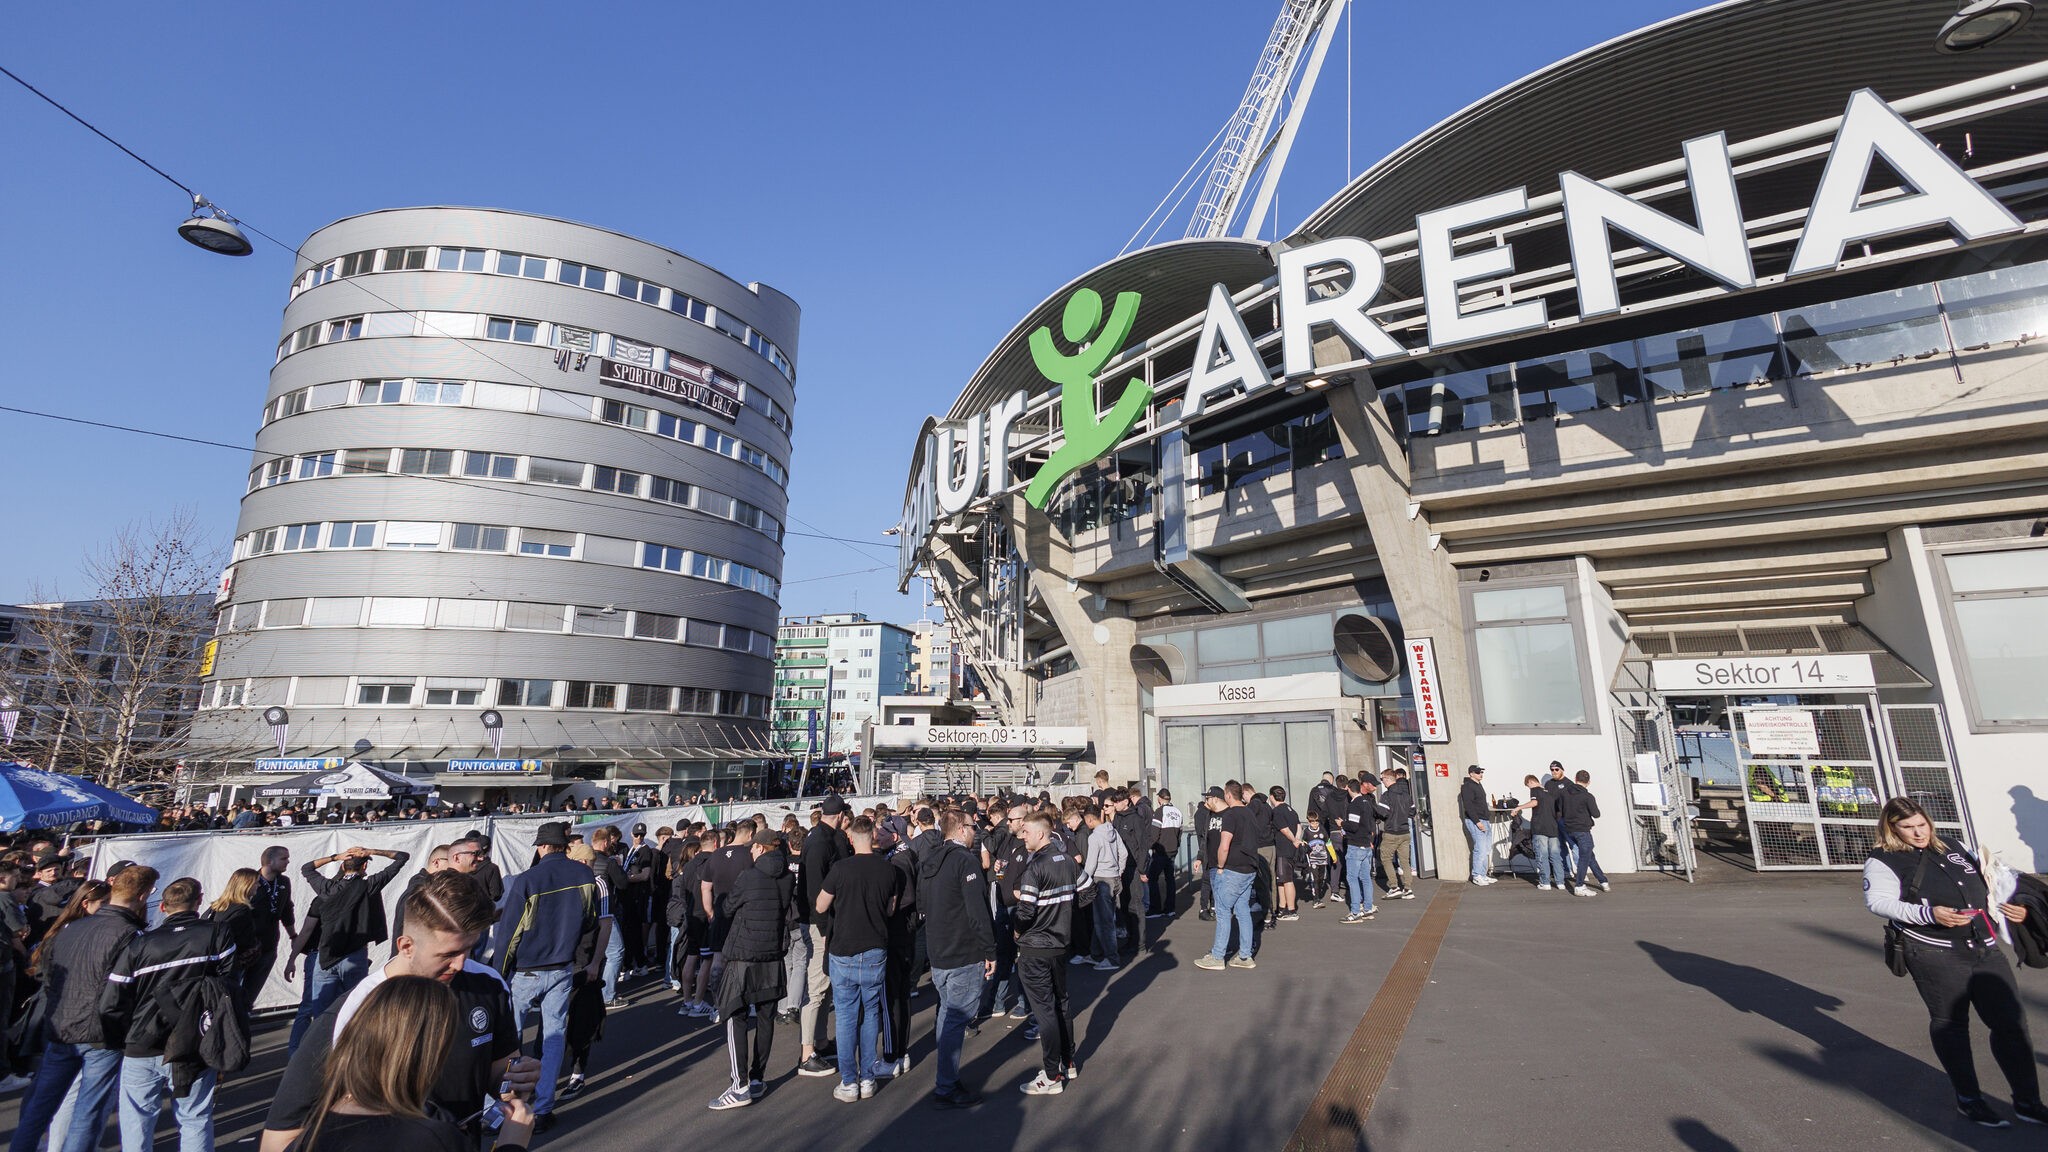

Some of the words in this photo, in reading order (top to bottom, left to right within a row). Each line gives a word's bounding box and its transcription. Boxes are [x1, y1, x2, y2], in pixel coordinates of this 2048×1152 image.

[1181, 88, 2026, 418] ARENA
[613, 363, 677, 393] SPORTKLUB
[680, 380, 710, 404] STURM
[712, 393, 733, 415] GRAZ
[1695, 662, 1780, 684] Sektor
[1791, 660, 1824, 683] 14
[1219, 684, 1255, 701] Kassa
[1412, 645, 1438, 735] WETTANNAHME
[928, 728, 987, 743] Sektoren
[991, 728, 1008, 743] 09
[1022, 729, 1037, 743] 13
[257, 760, 319, 770] PUNTIGAMER
[451, 760, 517, 771] PUNTIGAMER
[38, 805, 100, 827] PUNTIGAMER
